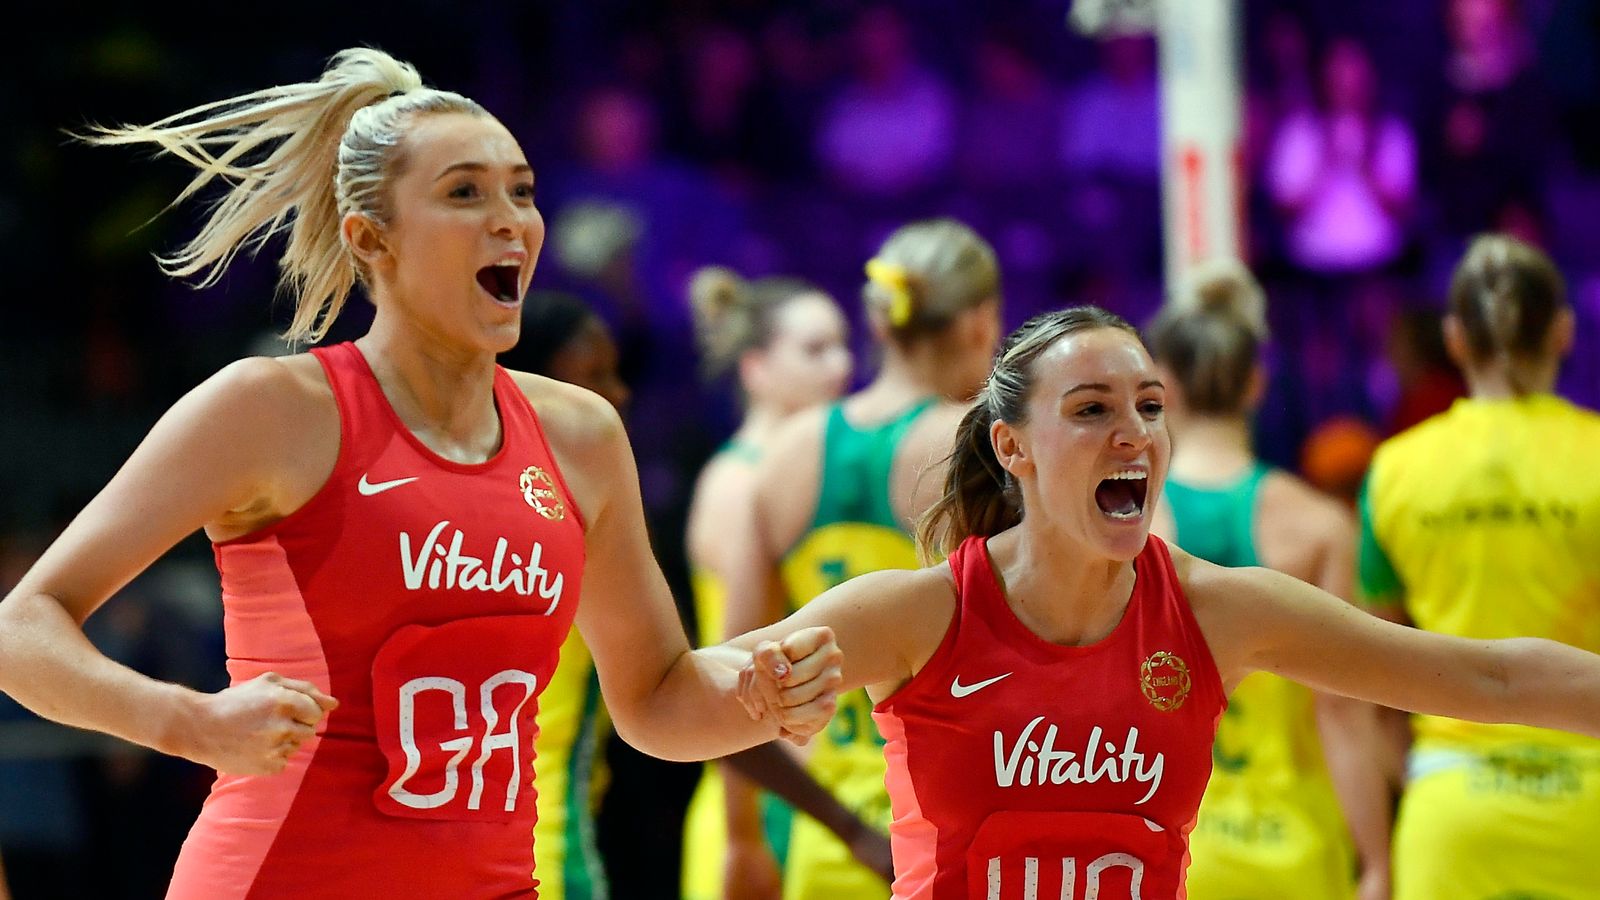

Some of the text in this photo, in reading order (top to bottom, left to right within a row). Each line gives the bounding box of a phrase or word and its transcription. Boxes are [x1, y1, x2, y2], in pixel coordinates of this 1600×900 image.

[400, 520, 564, 616] Vitality
[388, 669, 537, 812] GA
[994, 716, 1164, 805] Vitality
